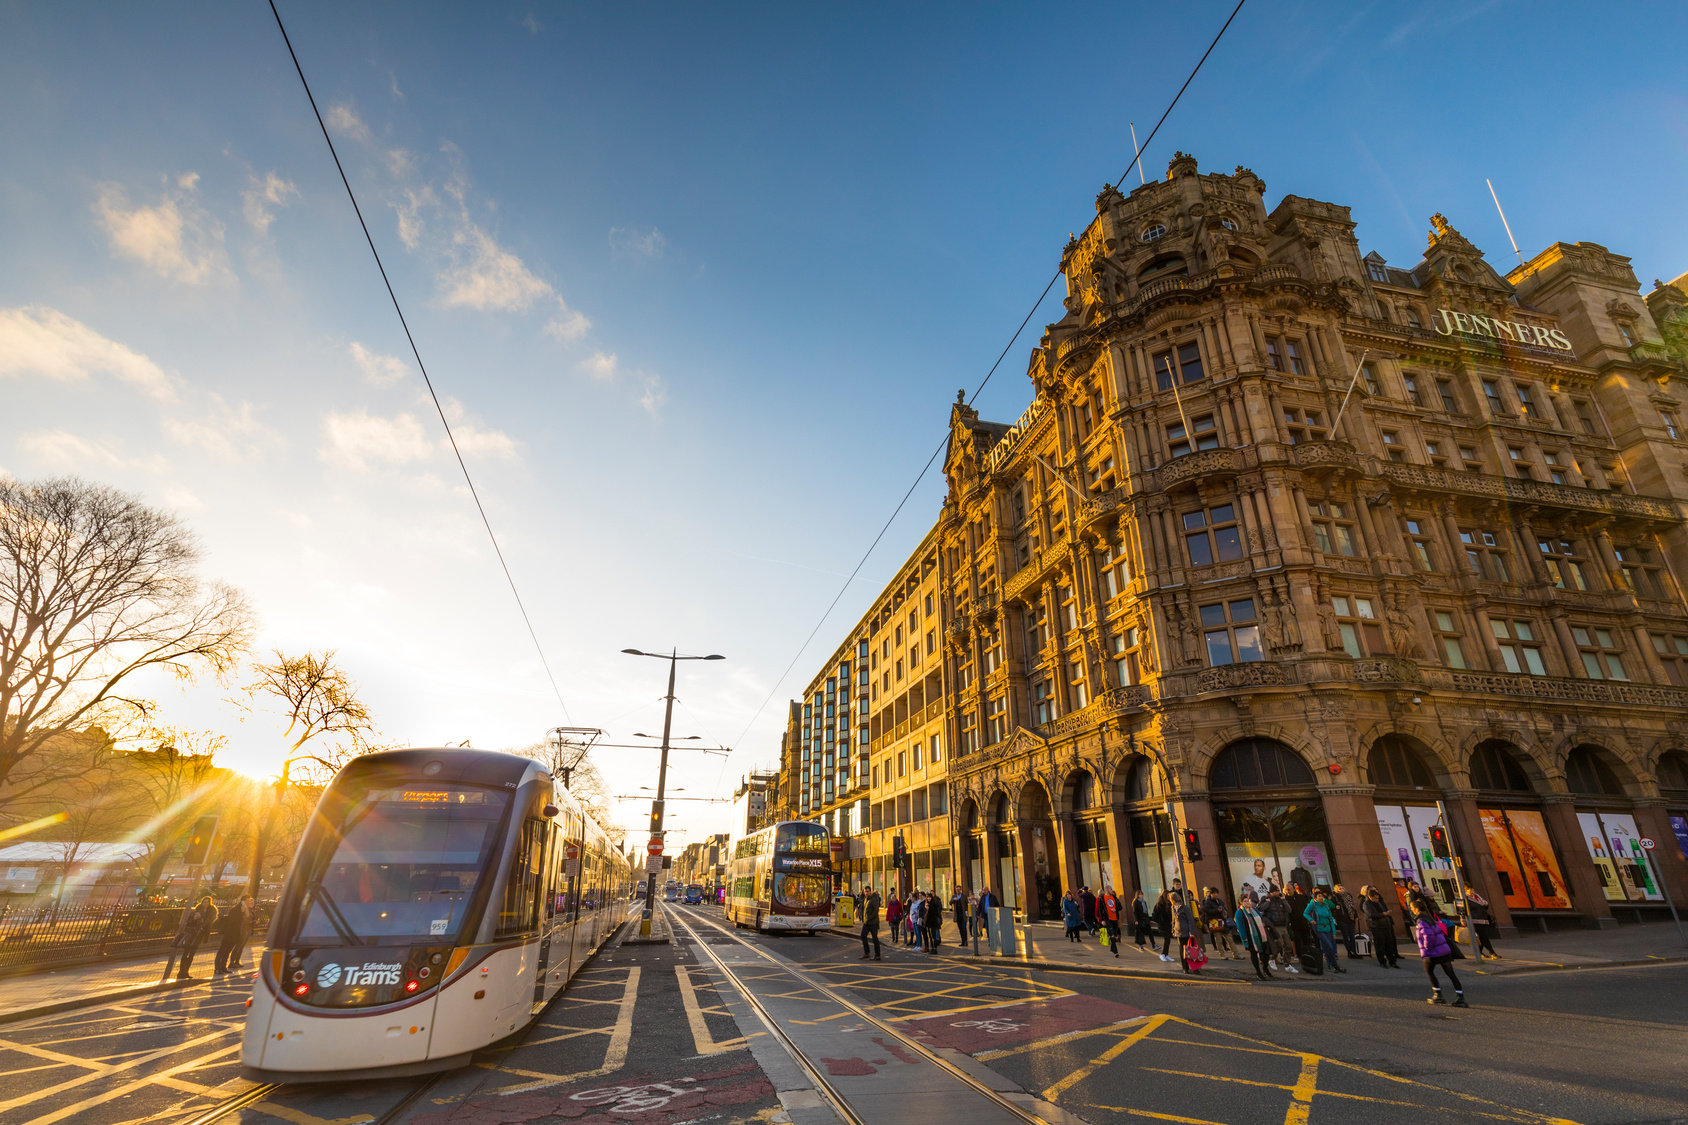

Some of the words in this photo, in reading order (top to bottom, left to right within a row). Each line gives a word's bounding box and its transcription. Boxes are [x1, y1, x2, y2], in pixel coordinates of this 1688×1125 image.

[1435, 308, 1572, 350] JENNERS
[810, 859, 822, 868] X15
[432, 923, 446, 931] 959
[362, 962, 402, 972] Edinburgh
[344, 966, 400, 985] Trams
